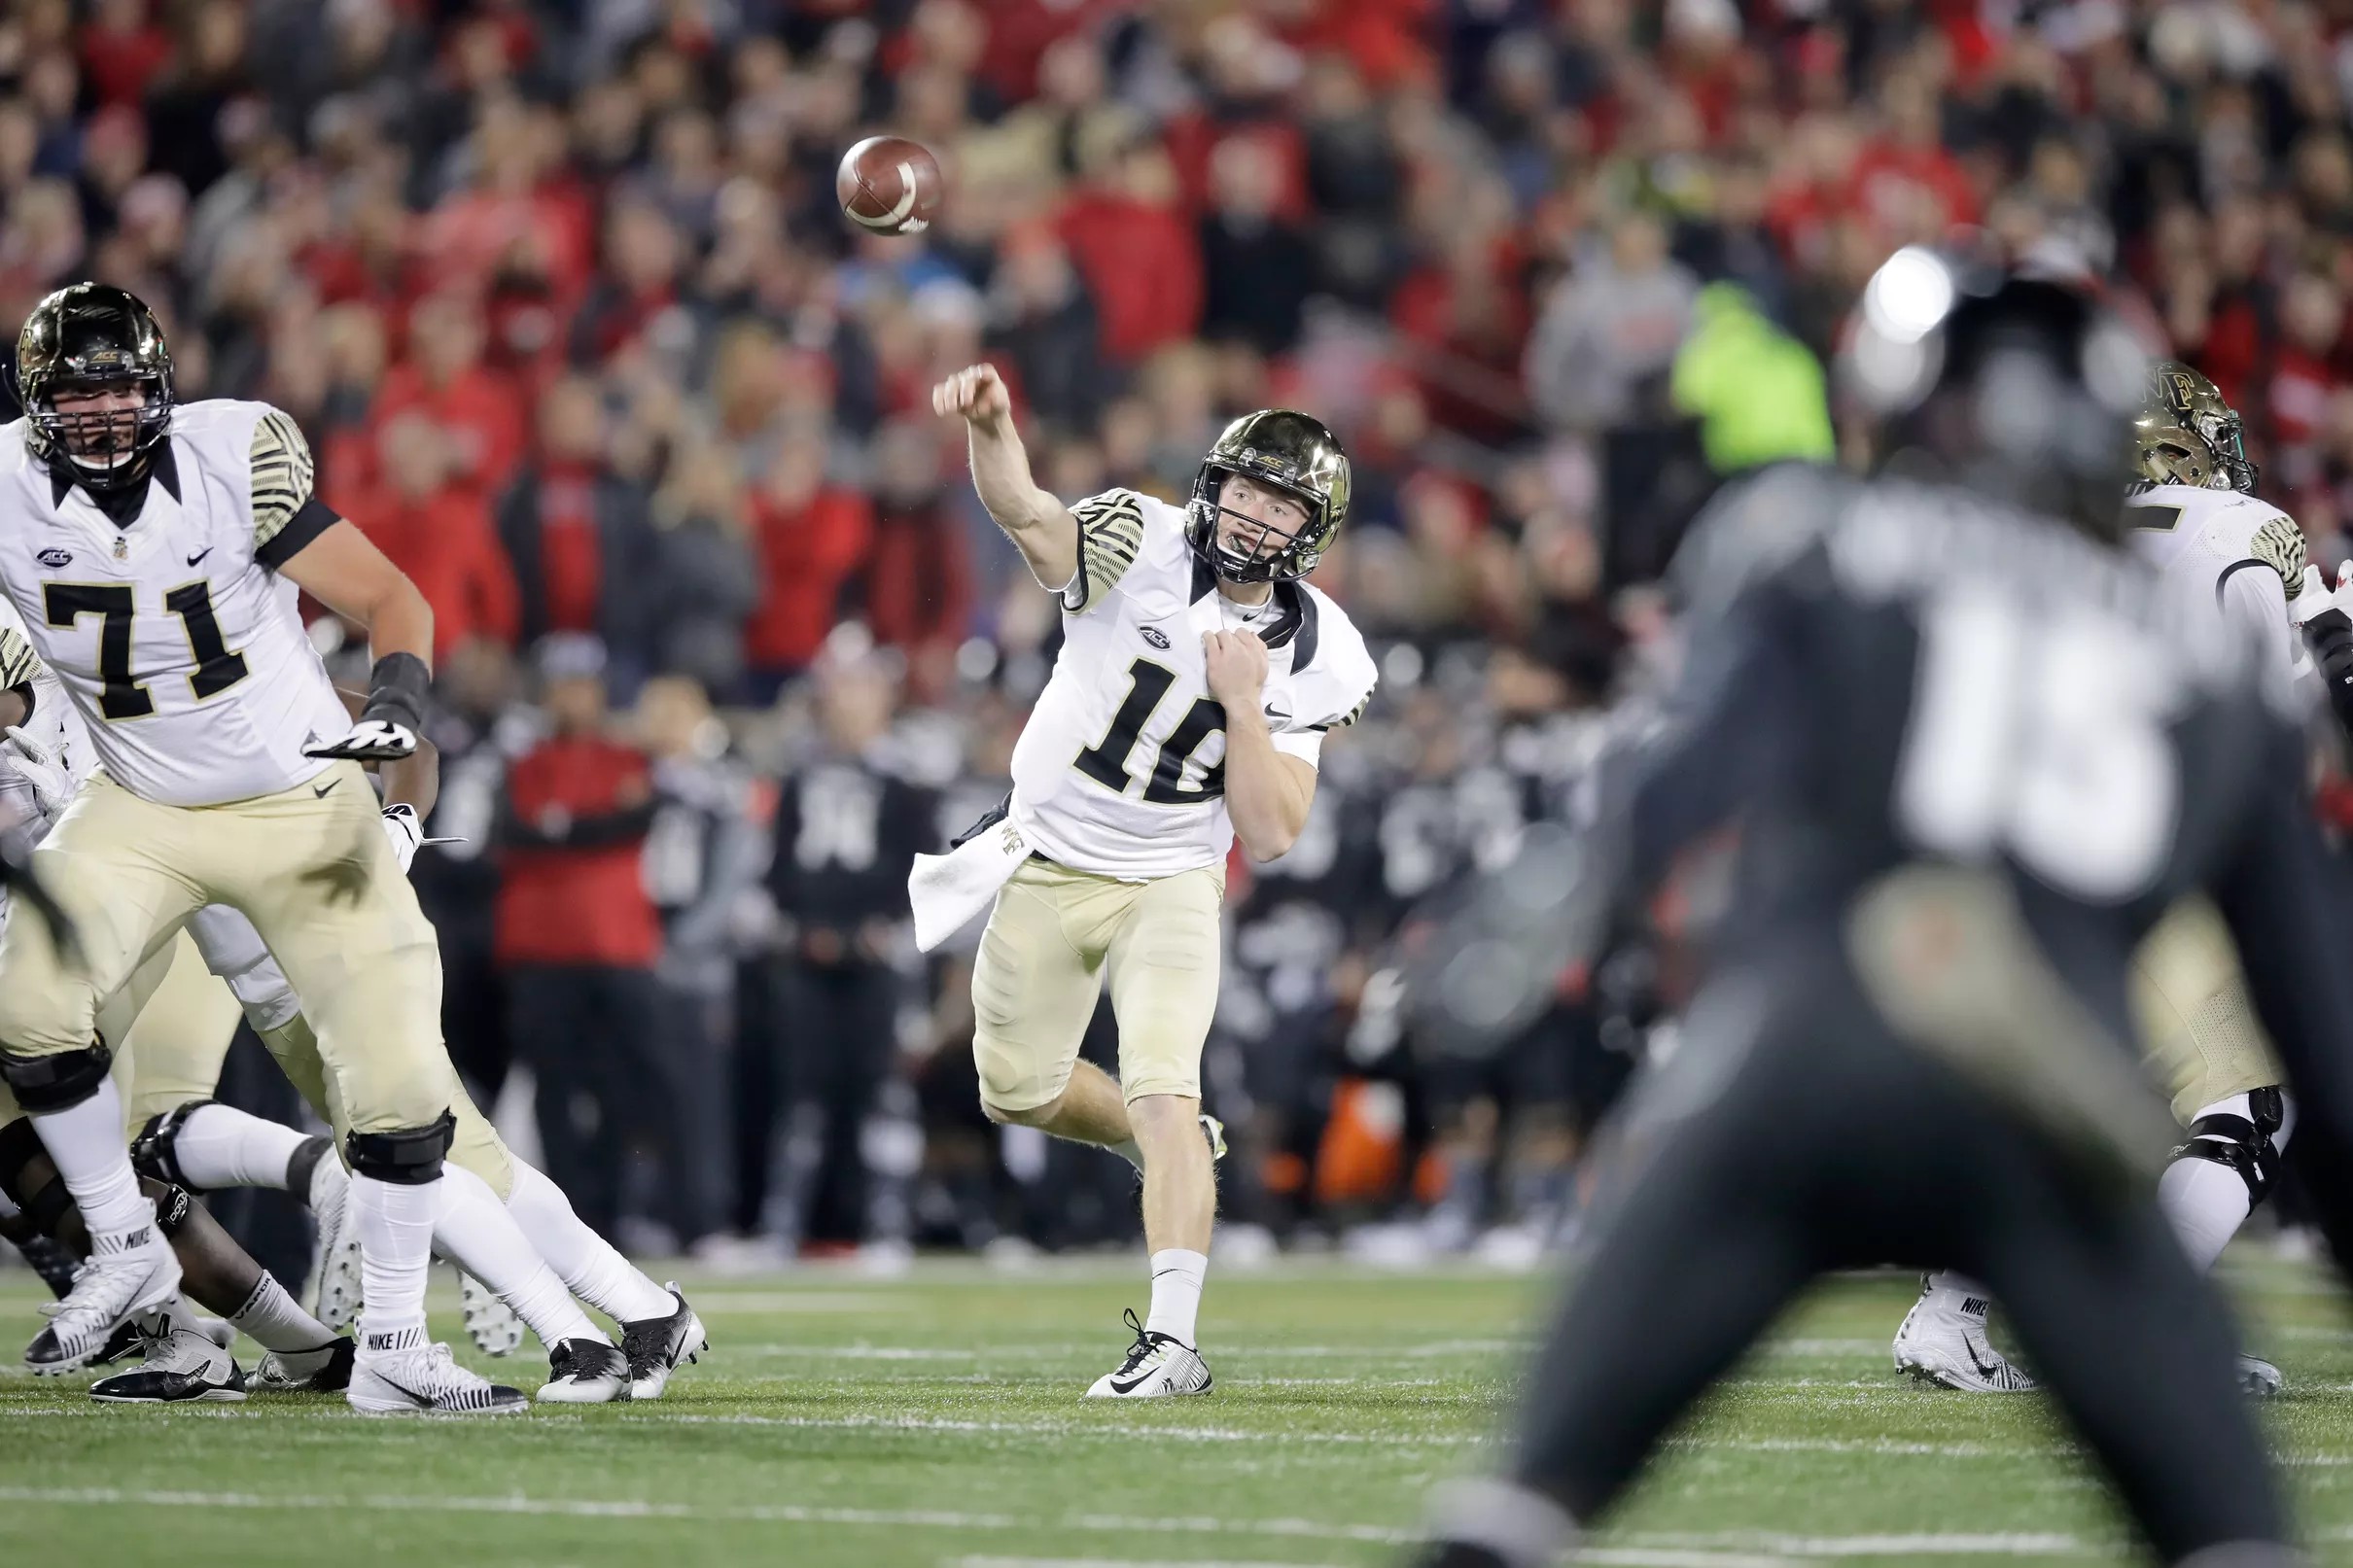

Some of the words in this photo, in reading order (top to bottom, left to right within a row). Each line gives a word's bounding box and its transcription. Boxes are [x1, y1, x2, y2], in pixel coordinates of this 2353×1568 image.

[91, 351, 118, 361] ACC
[1257, 455, 1284, 468] ACC
[40, 550, 71, 564] ACC
[1140, 628, 1171, 648] ACC
[40, 579, 250, 722] 71
[1069, 654, 1227, 807] 10
[234, 1277, 271, 1316] VAPOR
[1960, 1297, 1989, 1316] NIKE
[367, 1333, 394, 1350] NIKE
